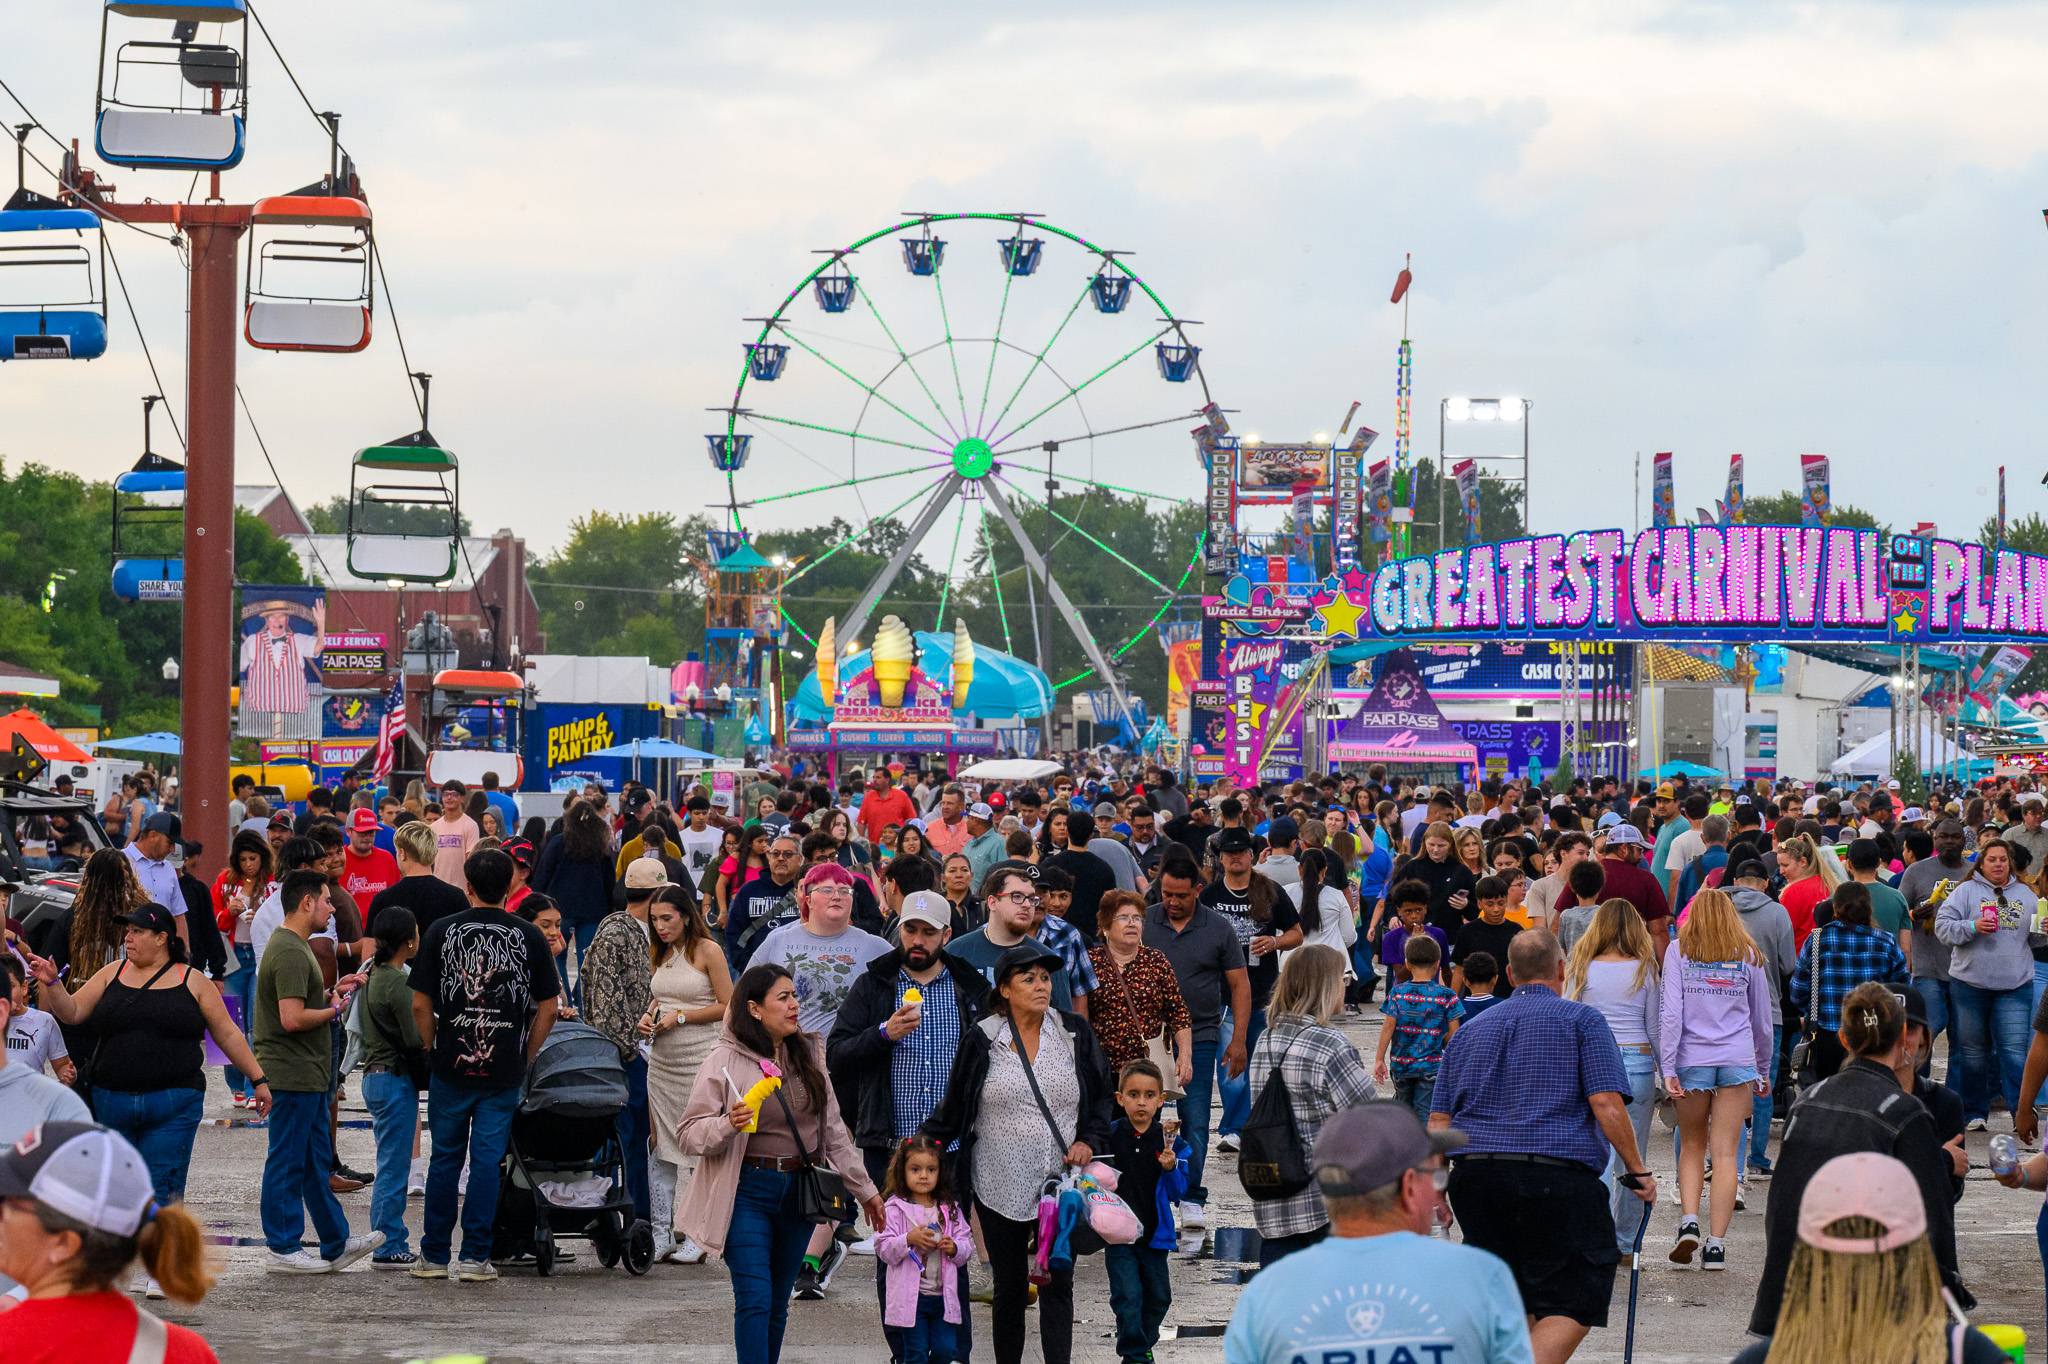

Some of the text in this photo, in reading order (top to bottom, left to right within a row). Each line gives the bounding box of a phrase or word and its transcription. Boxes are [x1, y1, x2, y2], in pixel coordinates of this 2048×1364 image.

[321, 181, 328, 190] 8
[26, 193, 38, 202] 14
[413, 434, 420, 442] 9
[151, 455, 162, 464] 13
[1249, 450, 1275, 463] Let's
[1275, 451, 1291, 464] Go
[1894, 537, 1922, 557] ON
[1890, 562, 1925, 582] THE
[1372, 526, 1888, 631] GREATEST CARNIVAL
[140, 581, 166, 591] SHARE
[1206, 606, 1302, 616] Wade Shows
[324, 636, 381, 646] SELF SERVICE
[323, 655, 382, 668] FAIR PASS
[1229, 640, 1281, 673] Always
[481, 660, 491, 668] 10
[1521, 664, 1552, 679] CASH
[1554, 664, 1573, 679] OR
[1197, 682, 1214, 690] SELF
[847, 698, 866, 707] ICE
[917, 699, 936, 708] ICE
[1195, 696, 1218, 705] FAIR
[836, 707, 878, 717] CREAM
[905, 708, 948, 718] CREAM
[1235, 675, 1252, 765] BEST
[1363, 713, 1439, 727] FAIR PASS
[548, 712, 608, 744] PUMP &
[1468, 723, 1513, 739] PASS
[840, 733, 870, 742] SLUSHIES
[548, 731, 614, 768] PANTRY
[1455, 749, 1474, 757] HERE
[323, 749, 342, 762] CASH
[343, 749, 354, 761] OR
[1198, 761, 1223, 771] CASH OR
[915, 895, 928, 911] LA
[786, 944, 859, 953] HERBOLOGY
[450, 1013, 514, 1037] No Weapon
[5, 1037, 29, 1050] MA
